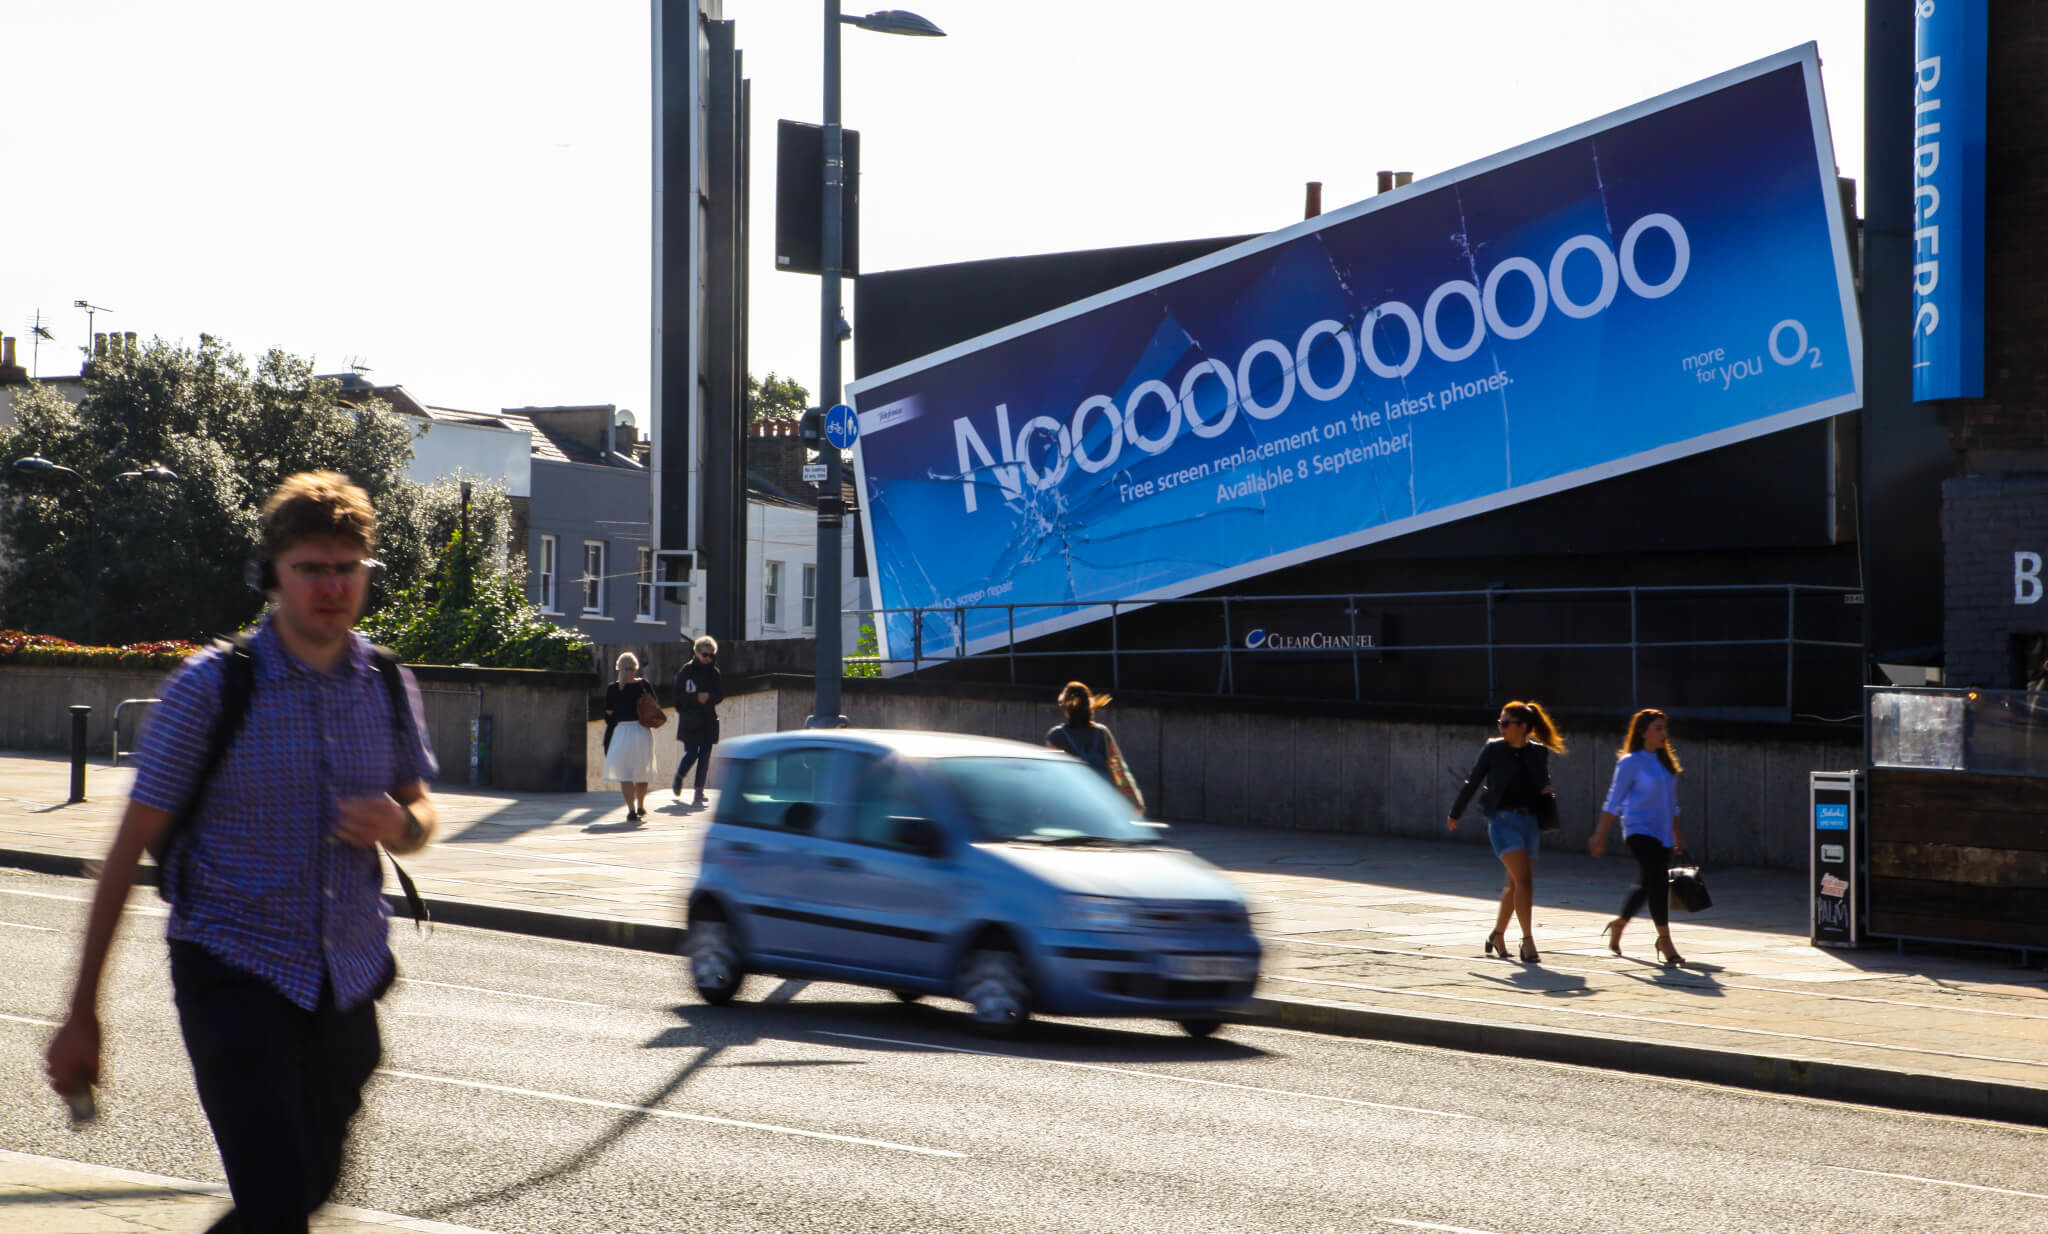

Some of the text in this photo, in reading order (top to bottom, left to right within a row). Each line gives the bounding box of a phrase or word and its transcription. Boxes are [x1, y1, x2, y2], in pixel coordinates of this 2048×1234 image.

[1682, 347, 1725, 371] more
[1768, 318, 1824, 369] O2
[1696, 355, 1763, 391] for you
[1119, 370, 1515, 503] Free screen replacement on the latest phones.
[1216, 465, 1294, 504] Available
[1297, 459, 1309, 479] 8
[2013, 551, 2044, 605] B
